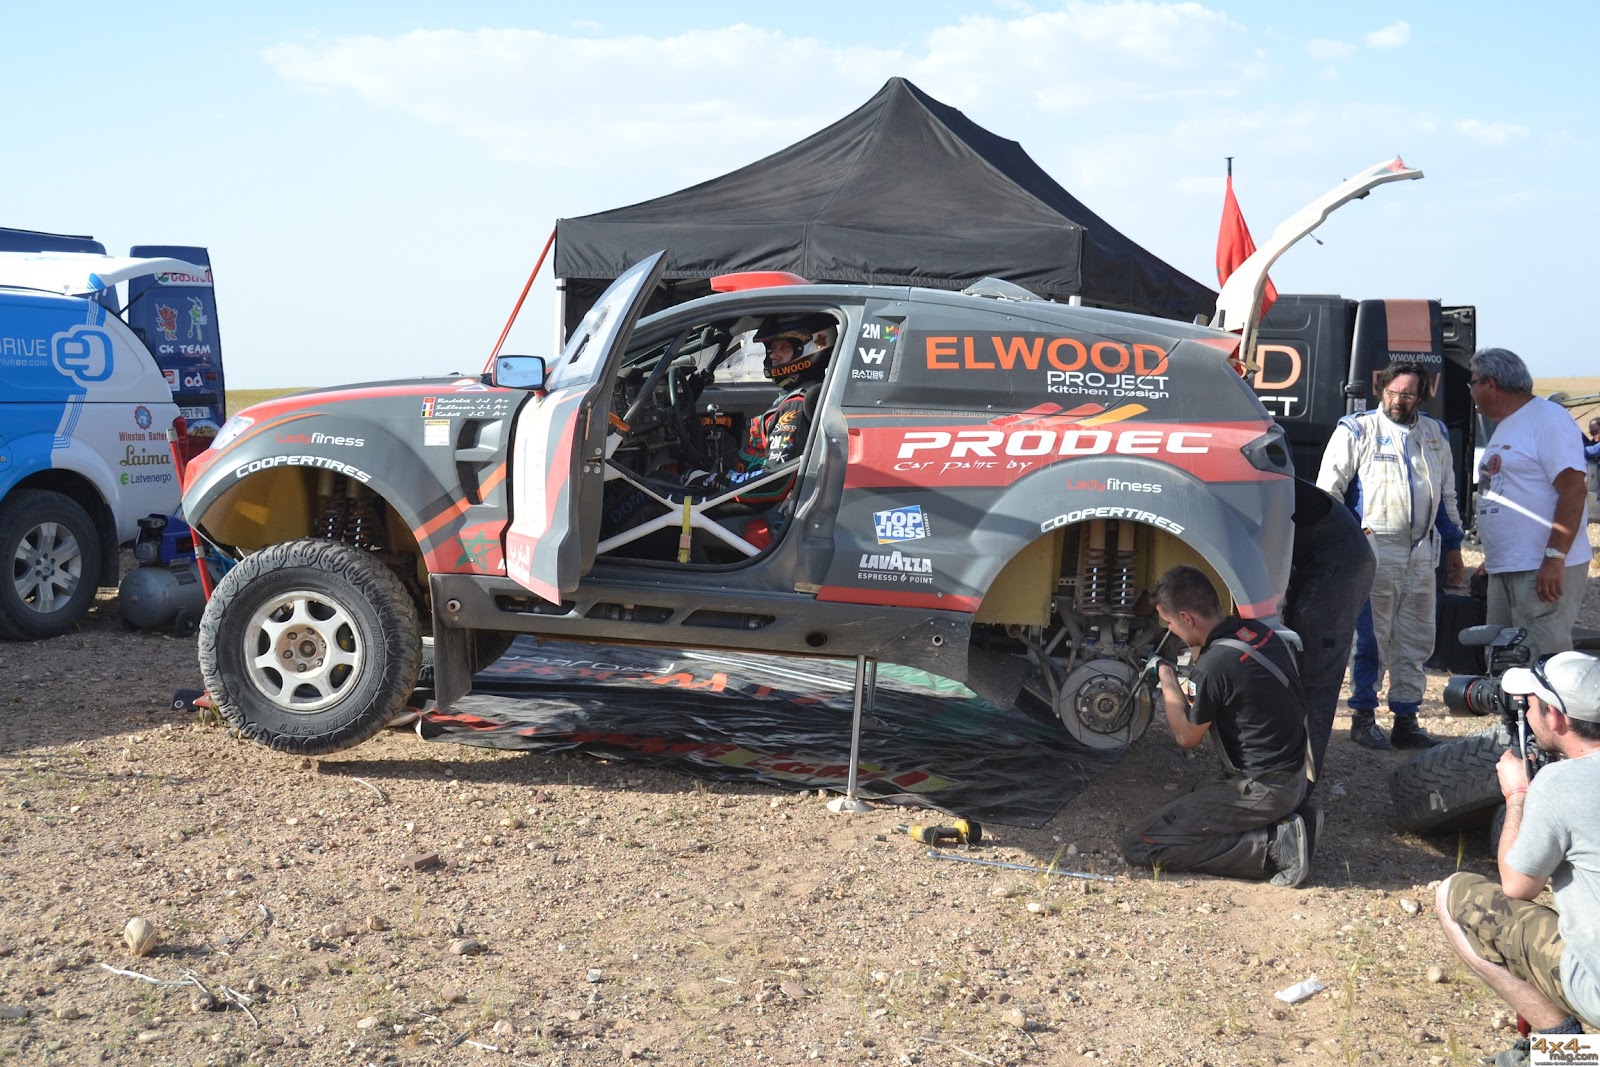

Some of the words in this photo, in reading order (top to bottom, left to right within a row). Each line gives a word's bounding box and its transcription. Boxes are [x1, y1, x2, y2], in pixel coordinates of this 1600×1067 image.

[862, 323, 880, 339] 2M
[0, 338, 47, 356] RIVE
[159, 345, 174, 354] CK
[179, 345, 211, 354] TEAM
[926, 336, 1169, 374] ELWOOD
[771, 360, 811, 377] ELWOOD
[1048, 371, 1169, 390] PROJECT
[1047, 385, 1109, 396] Kitchen
[1113, 387, 1169, 399] Design
[119, 432, 146, 441] Winston
[276, 432, 365, 448] Ladyfitness
[897, 430, 1212, 458] PRODEC
[119, 445, 171, 466] Laima
[893, 461, 934, 471] Car
[1006, 459, 1033, 473] by
[131, 474, 172, 484] Latvenergo
[877, 512, 921, 527] TOP
[876, 521, 925, 538] class
[859, 551, 933, 573] LAVAZZA
[858, 572, 898, 582] ESPRESSO
[909, 576, 933, 584] POINT
